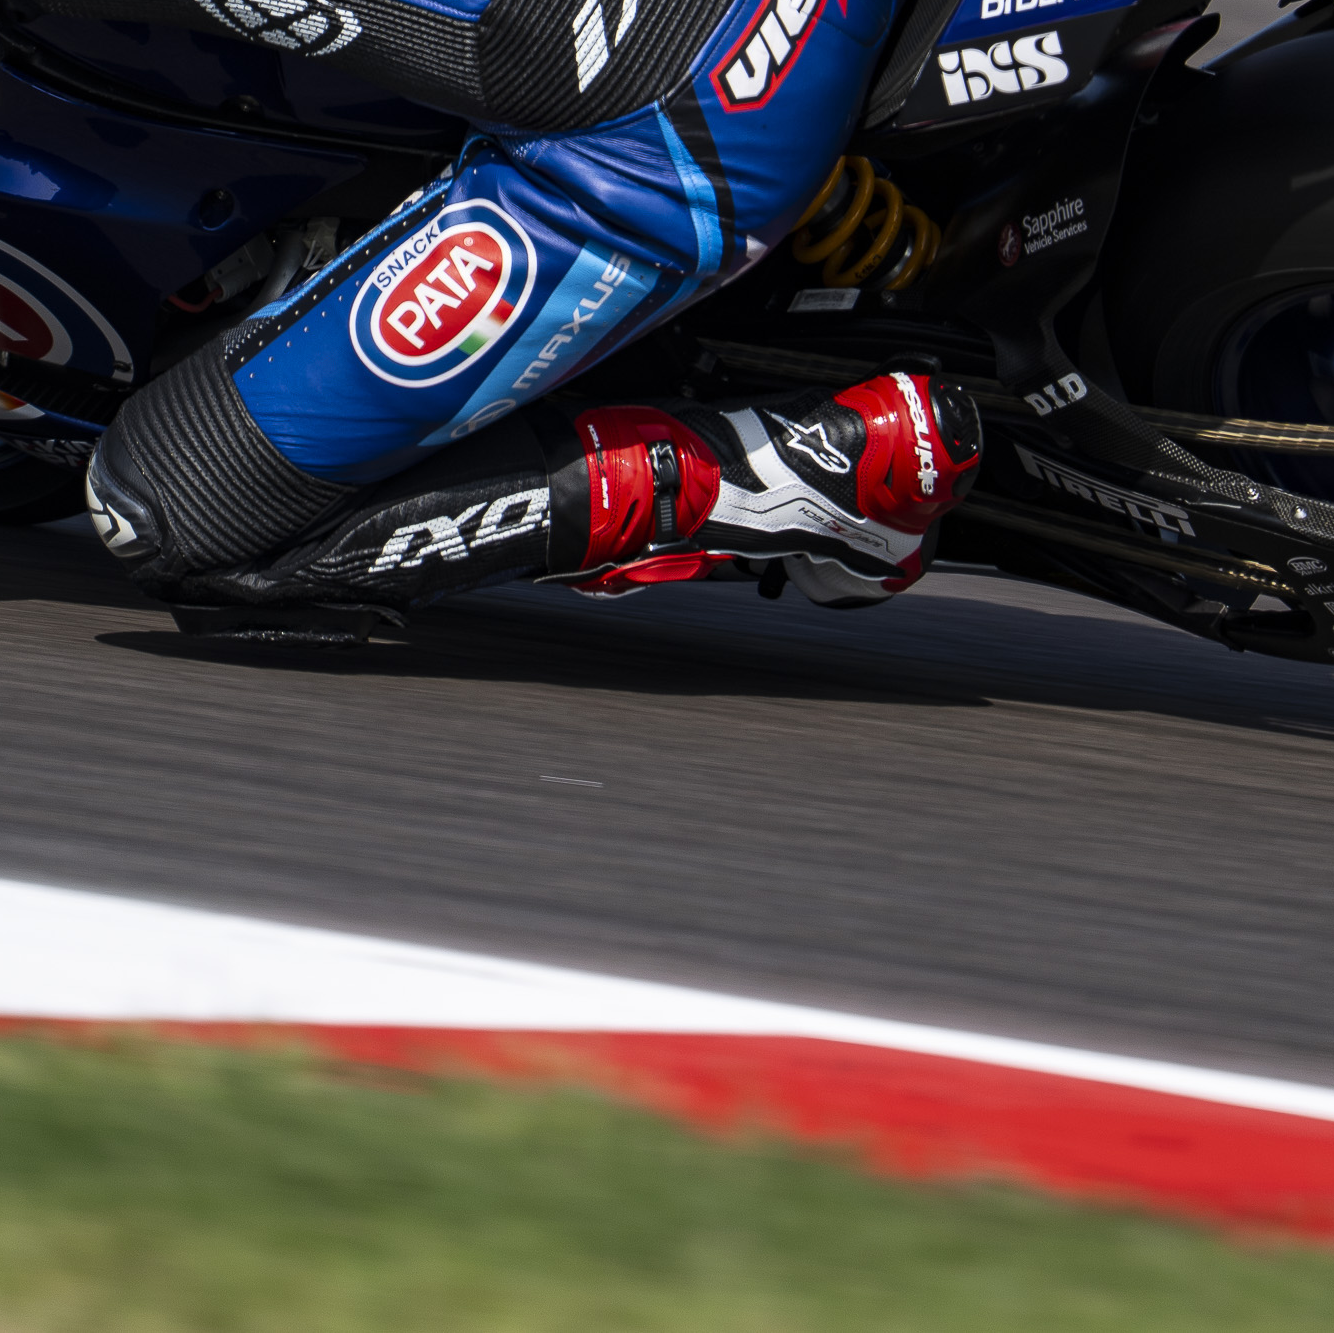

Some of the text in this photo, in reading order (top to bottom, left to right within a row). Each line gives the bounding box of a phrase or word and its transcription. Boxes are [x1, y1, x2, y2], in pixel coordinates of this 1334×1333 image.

[1022, 197, 1084, 237] Sapphire
[1024, 219, 1088, 255] Vehicle Services
[375, 223, 442, 289] SNACK
[385, 243, 495, 350] PATA
[513, 254, 633, 390] MAXUS
[1015, 444, 1196, 538] PIRELLI
[1292, 559, 1325, 572] BMC
